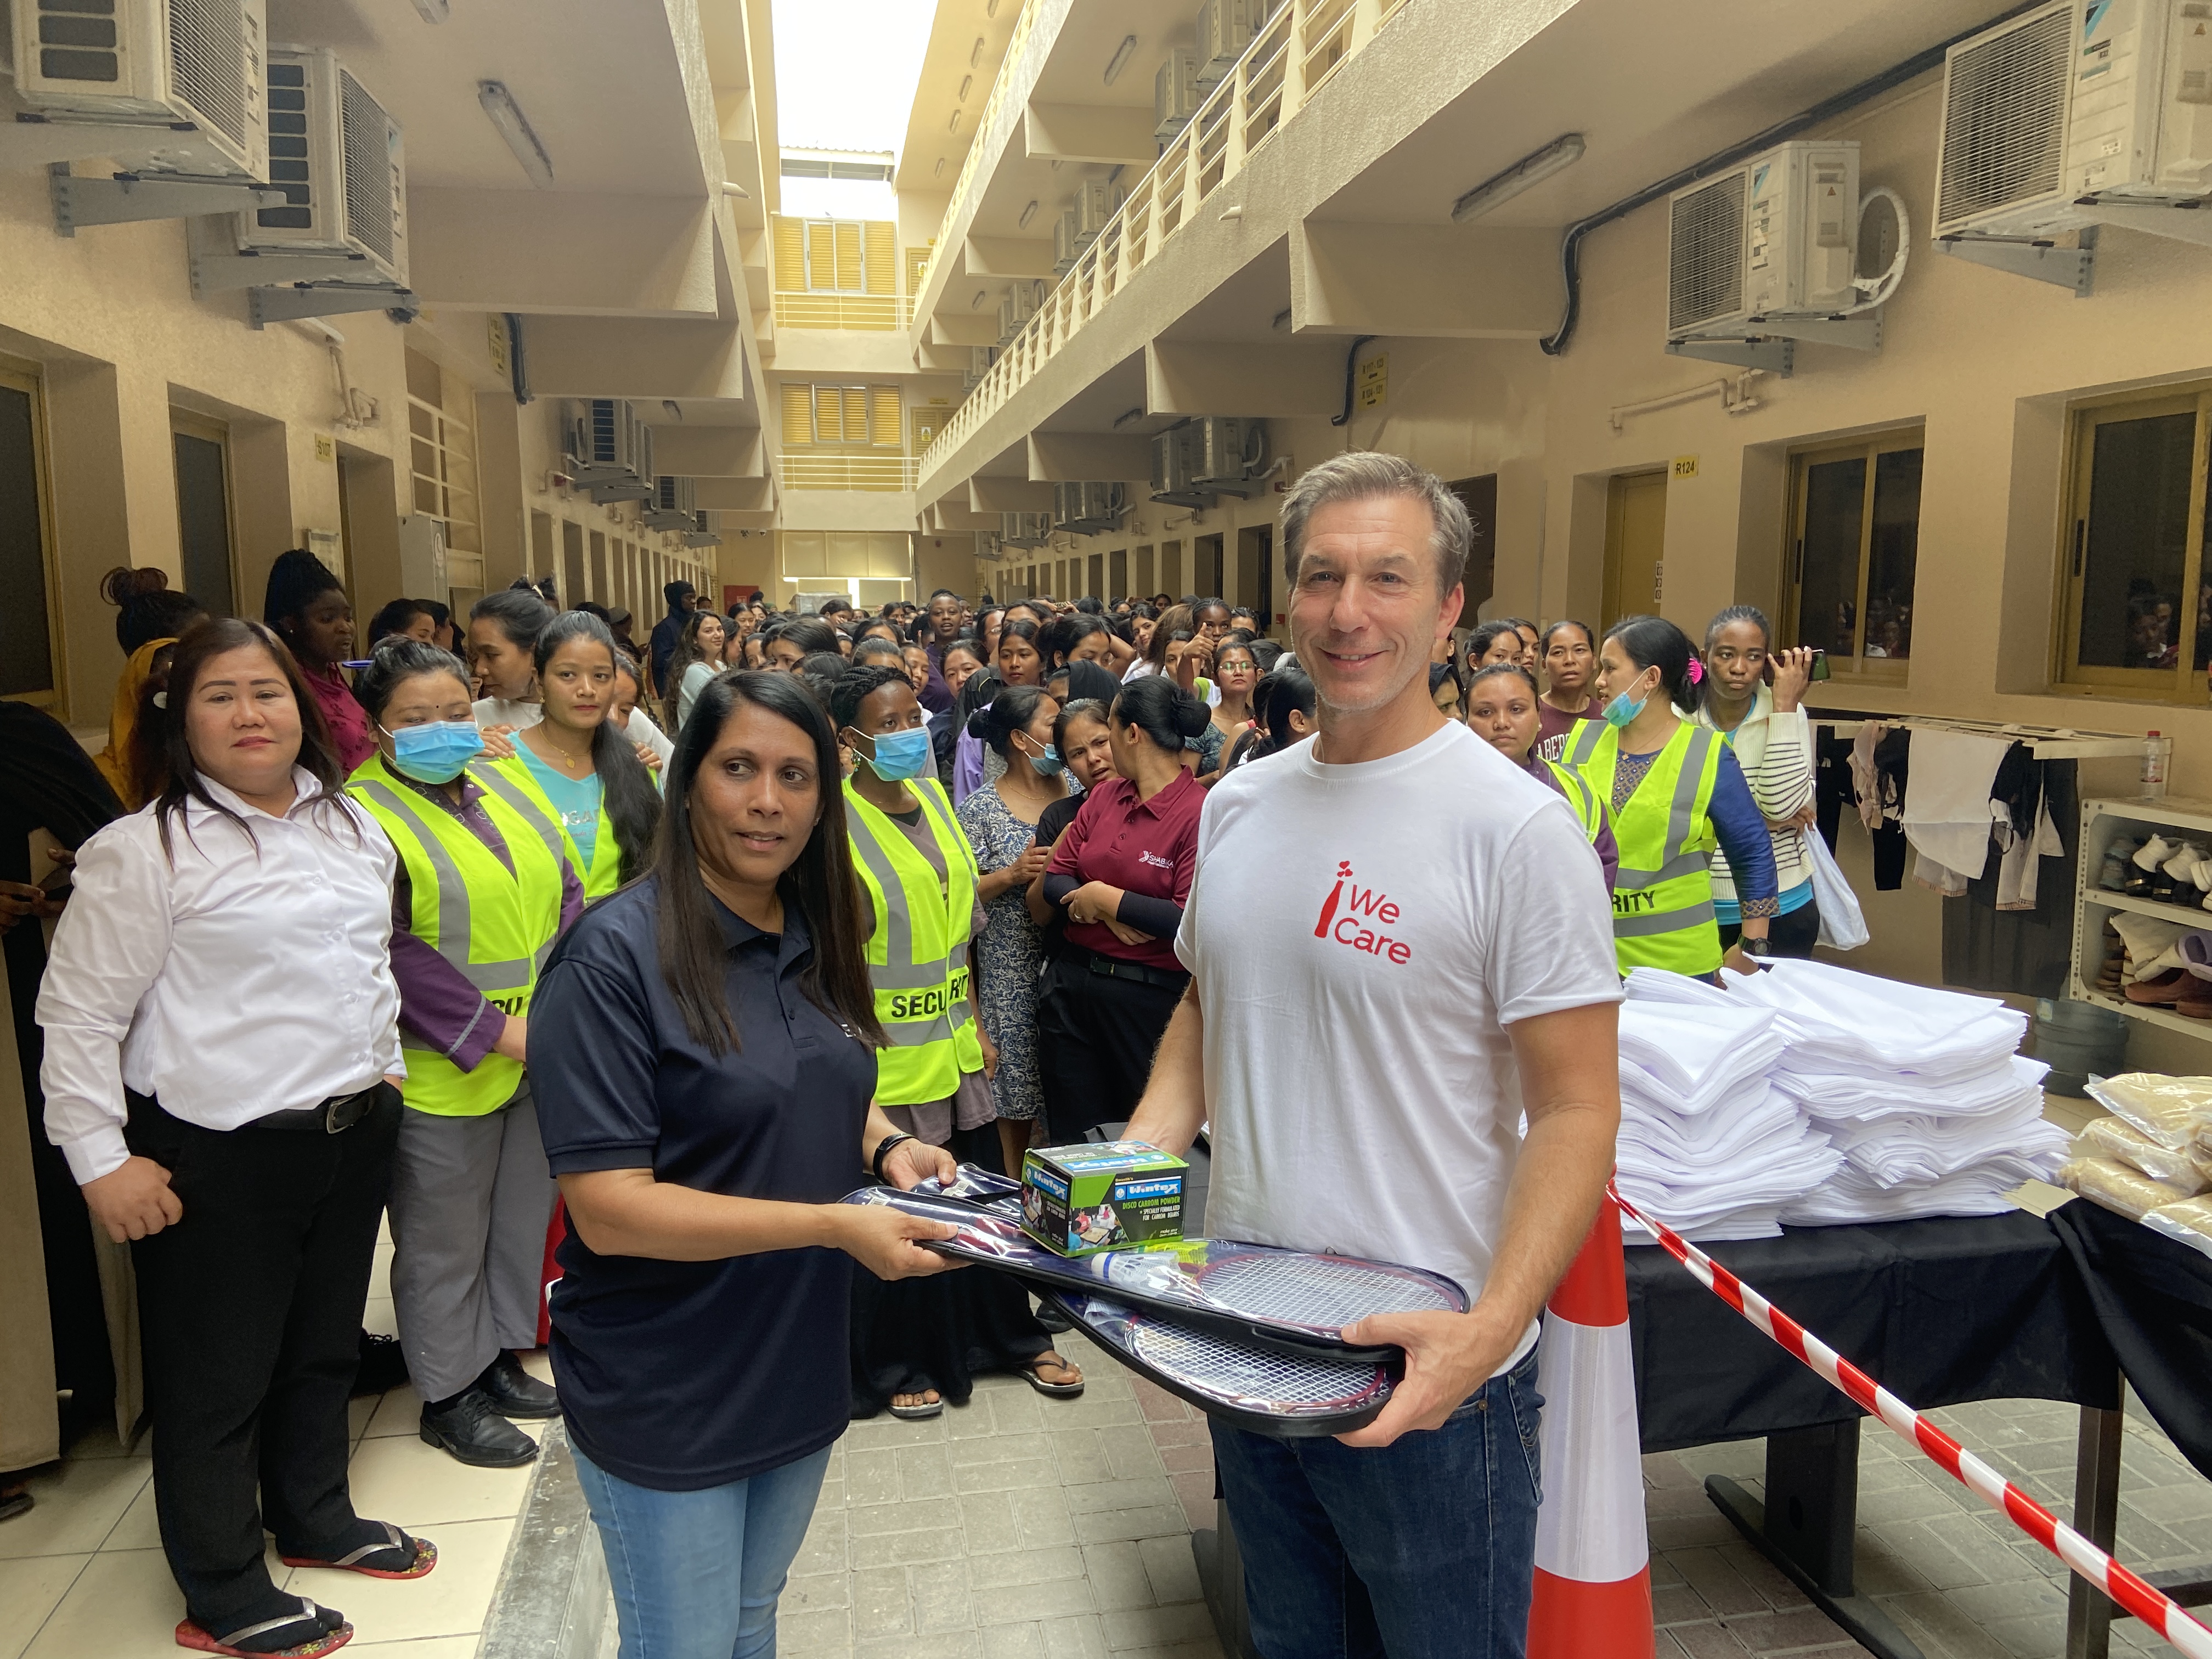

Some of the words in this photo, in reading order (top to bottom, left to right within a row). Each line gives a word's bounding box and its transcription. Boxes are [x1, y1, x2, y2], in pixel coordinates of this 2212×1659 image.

[1676, 460, 1695, 476] R124
[1351, 884, 1400, 924] We
[1612, 890, 1656, 912] RITY
[1334, 917, 1411, 964] Care
[1122, 1201, 1137, 1210] DISCO
[1138, 1199, 1159, 1208] CARROM
[1160, 1196, 1181, 1205] POWDER
[1160, 1204, 1181, 1213] FORMULATED
[1167, 1210, 1180, 1218] BOARDS
